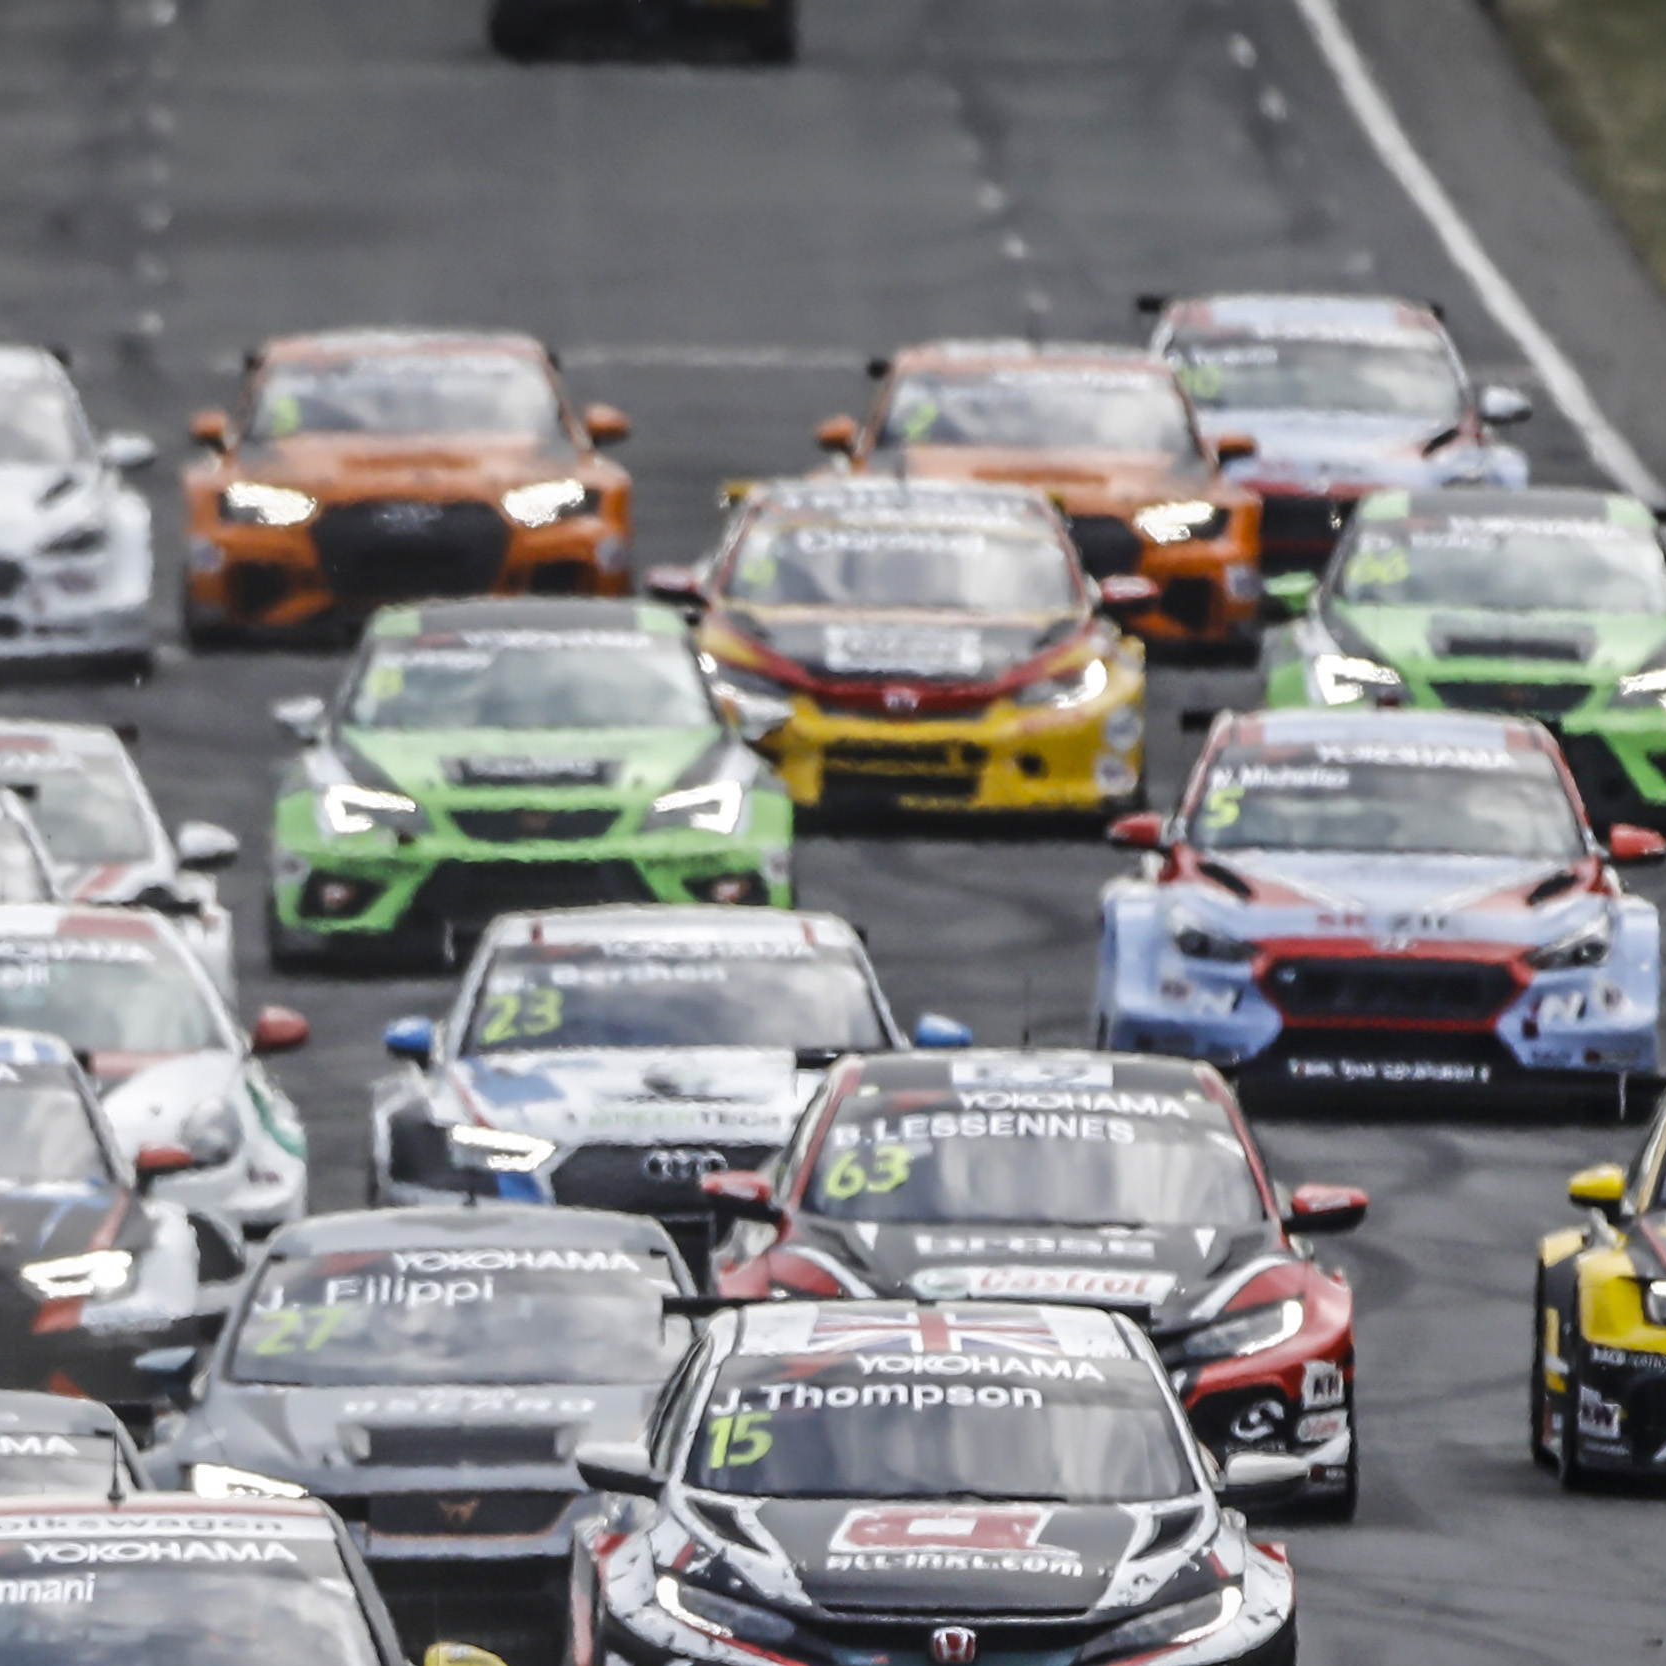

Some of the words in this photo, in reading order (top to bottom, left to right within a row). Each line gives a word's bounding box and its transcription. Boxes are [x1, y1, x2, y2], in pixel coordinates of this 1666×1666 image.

[1203, 786, 1244, 828] 5
[480, 988, 563, 1044] 23
[958, 1092, 1190, 1118] YOKOHAMA
[825, 1144, 911, 1199] 63
[391, 1251, 640, 1273] YOKOHAMA
[326, 1276, 494, 1307] Filippi
[981, 1269, 1150, 1295] Castrol
[253, 1307, 346, 1355] 27
[856, 1355, 1106, 1381] YOKOHAMA
[711, 1387, 752, 1416] J.
[763, 1383, 1043, 1411] Thompson
[707, 1413, 773, 1469] 15
[24, 1543, 297, 1564] YOKOHAMA
